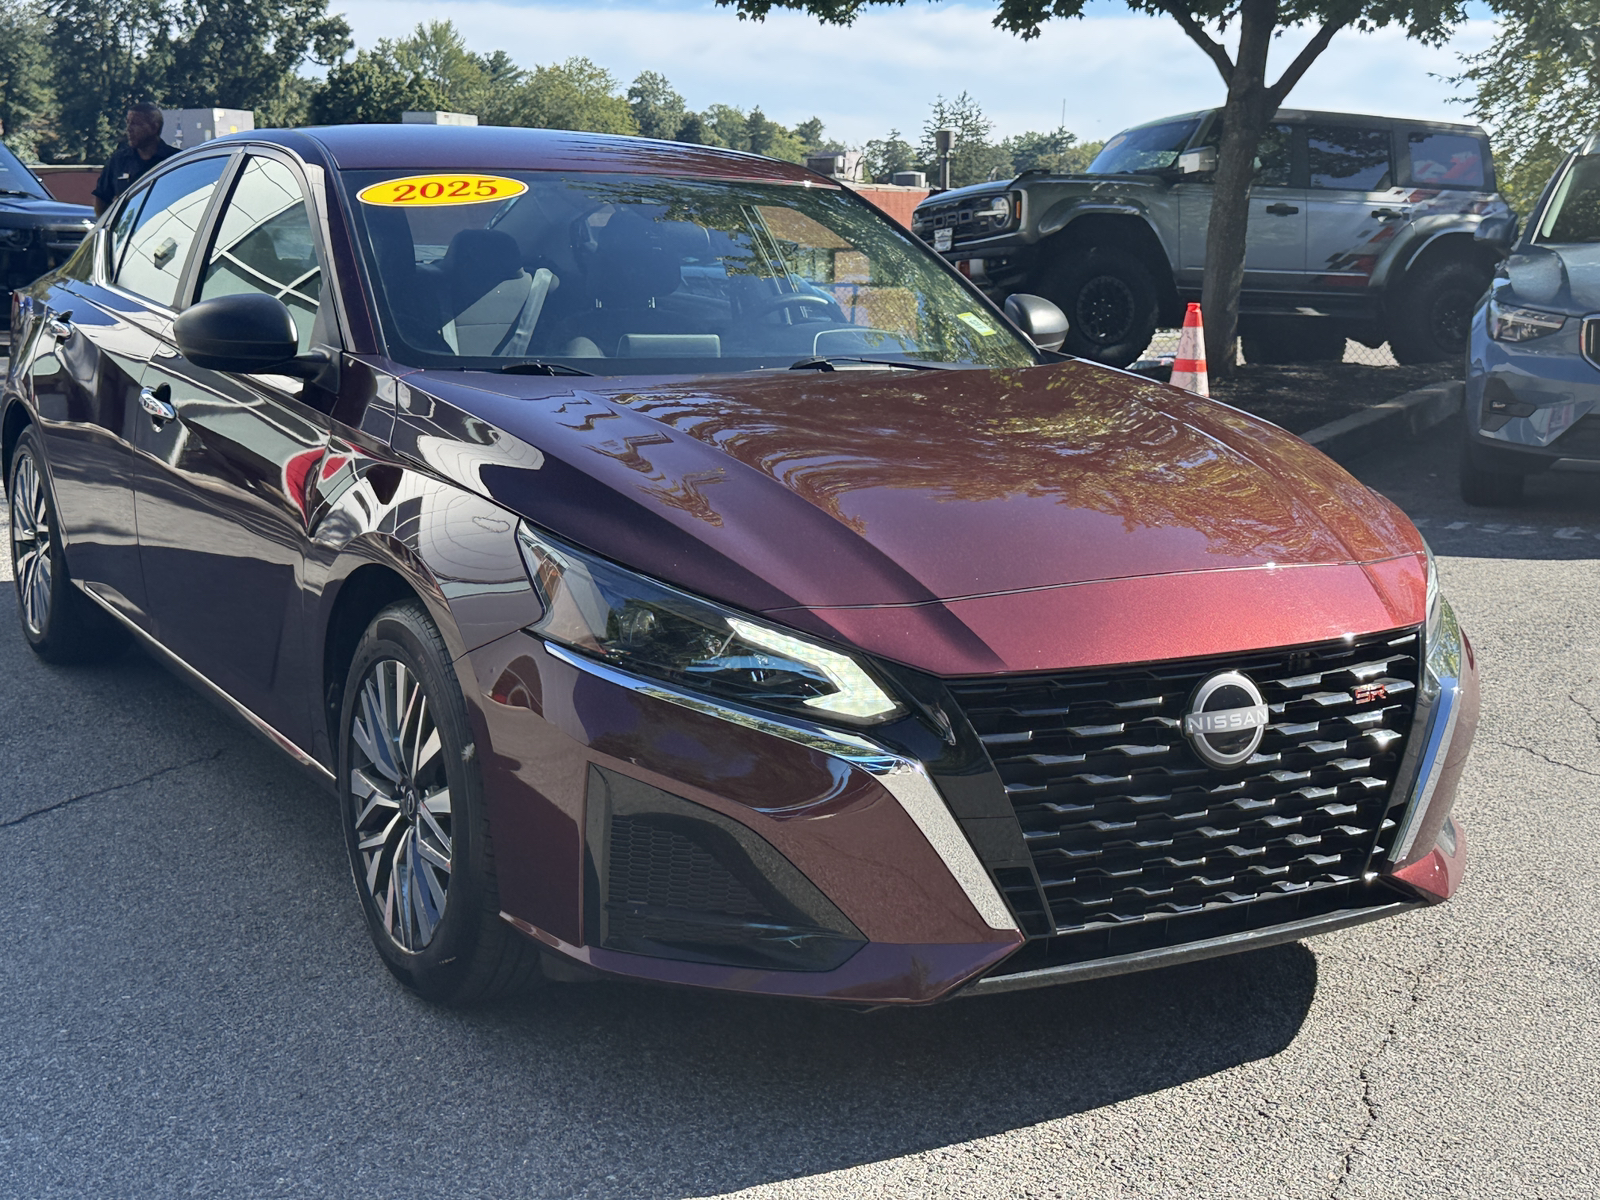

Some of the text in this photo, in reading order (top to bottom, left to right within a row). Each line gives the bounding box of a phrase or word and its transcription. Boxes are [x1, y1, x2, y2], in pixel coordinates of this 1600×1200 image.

[392, 179, 498, 203] 2025
[1354, 683, 1387, 705] SR
[1187, 708, 1268, 732] NISSAN
